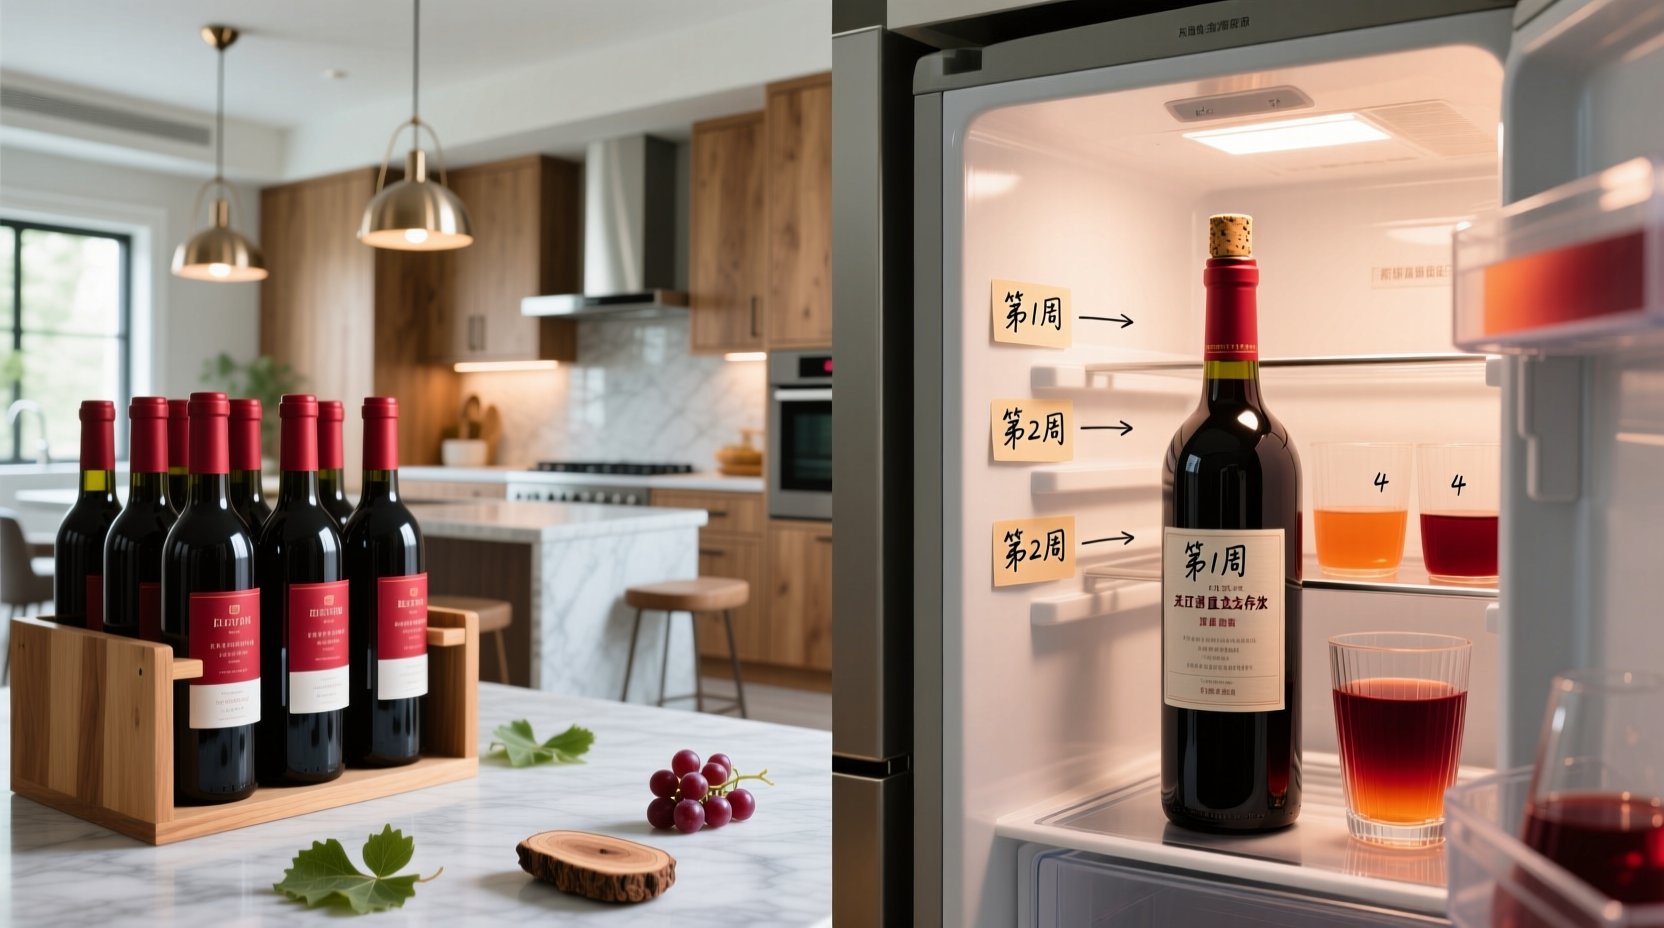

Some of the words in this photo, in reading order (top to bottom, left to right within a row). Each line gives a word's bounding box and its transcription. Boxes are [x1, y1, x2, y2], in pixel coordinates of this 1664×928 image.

[1004, 290, 1062, 333] 第1周
[1002, 407, 1065, 450] 第2周
[1373, 472, 1390, 493] 4
[1451, 474, 1467, 497] 4
[1003, 528, 1066, 573] 第2周
[1184, 540, 1246, 582] 第1周
